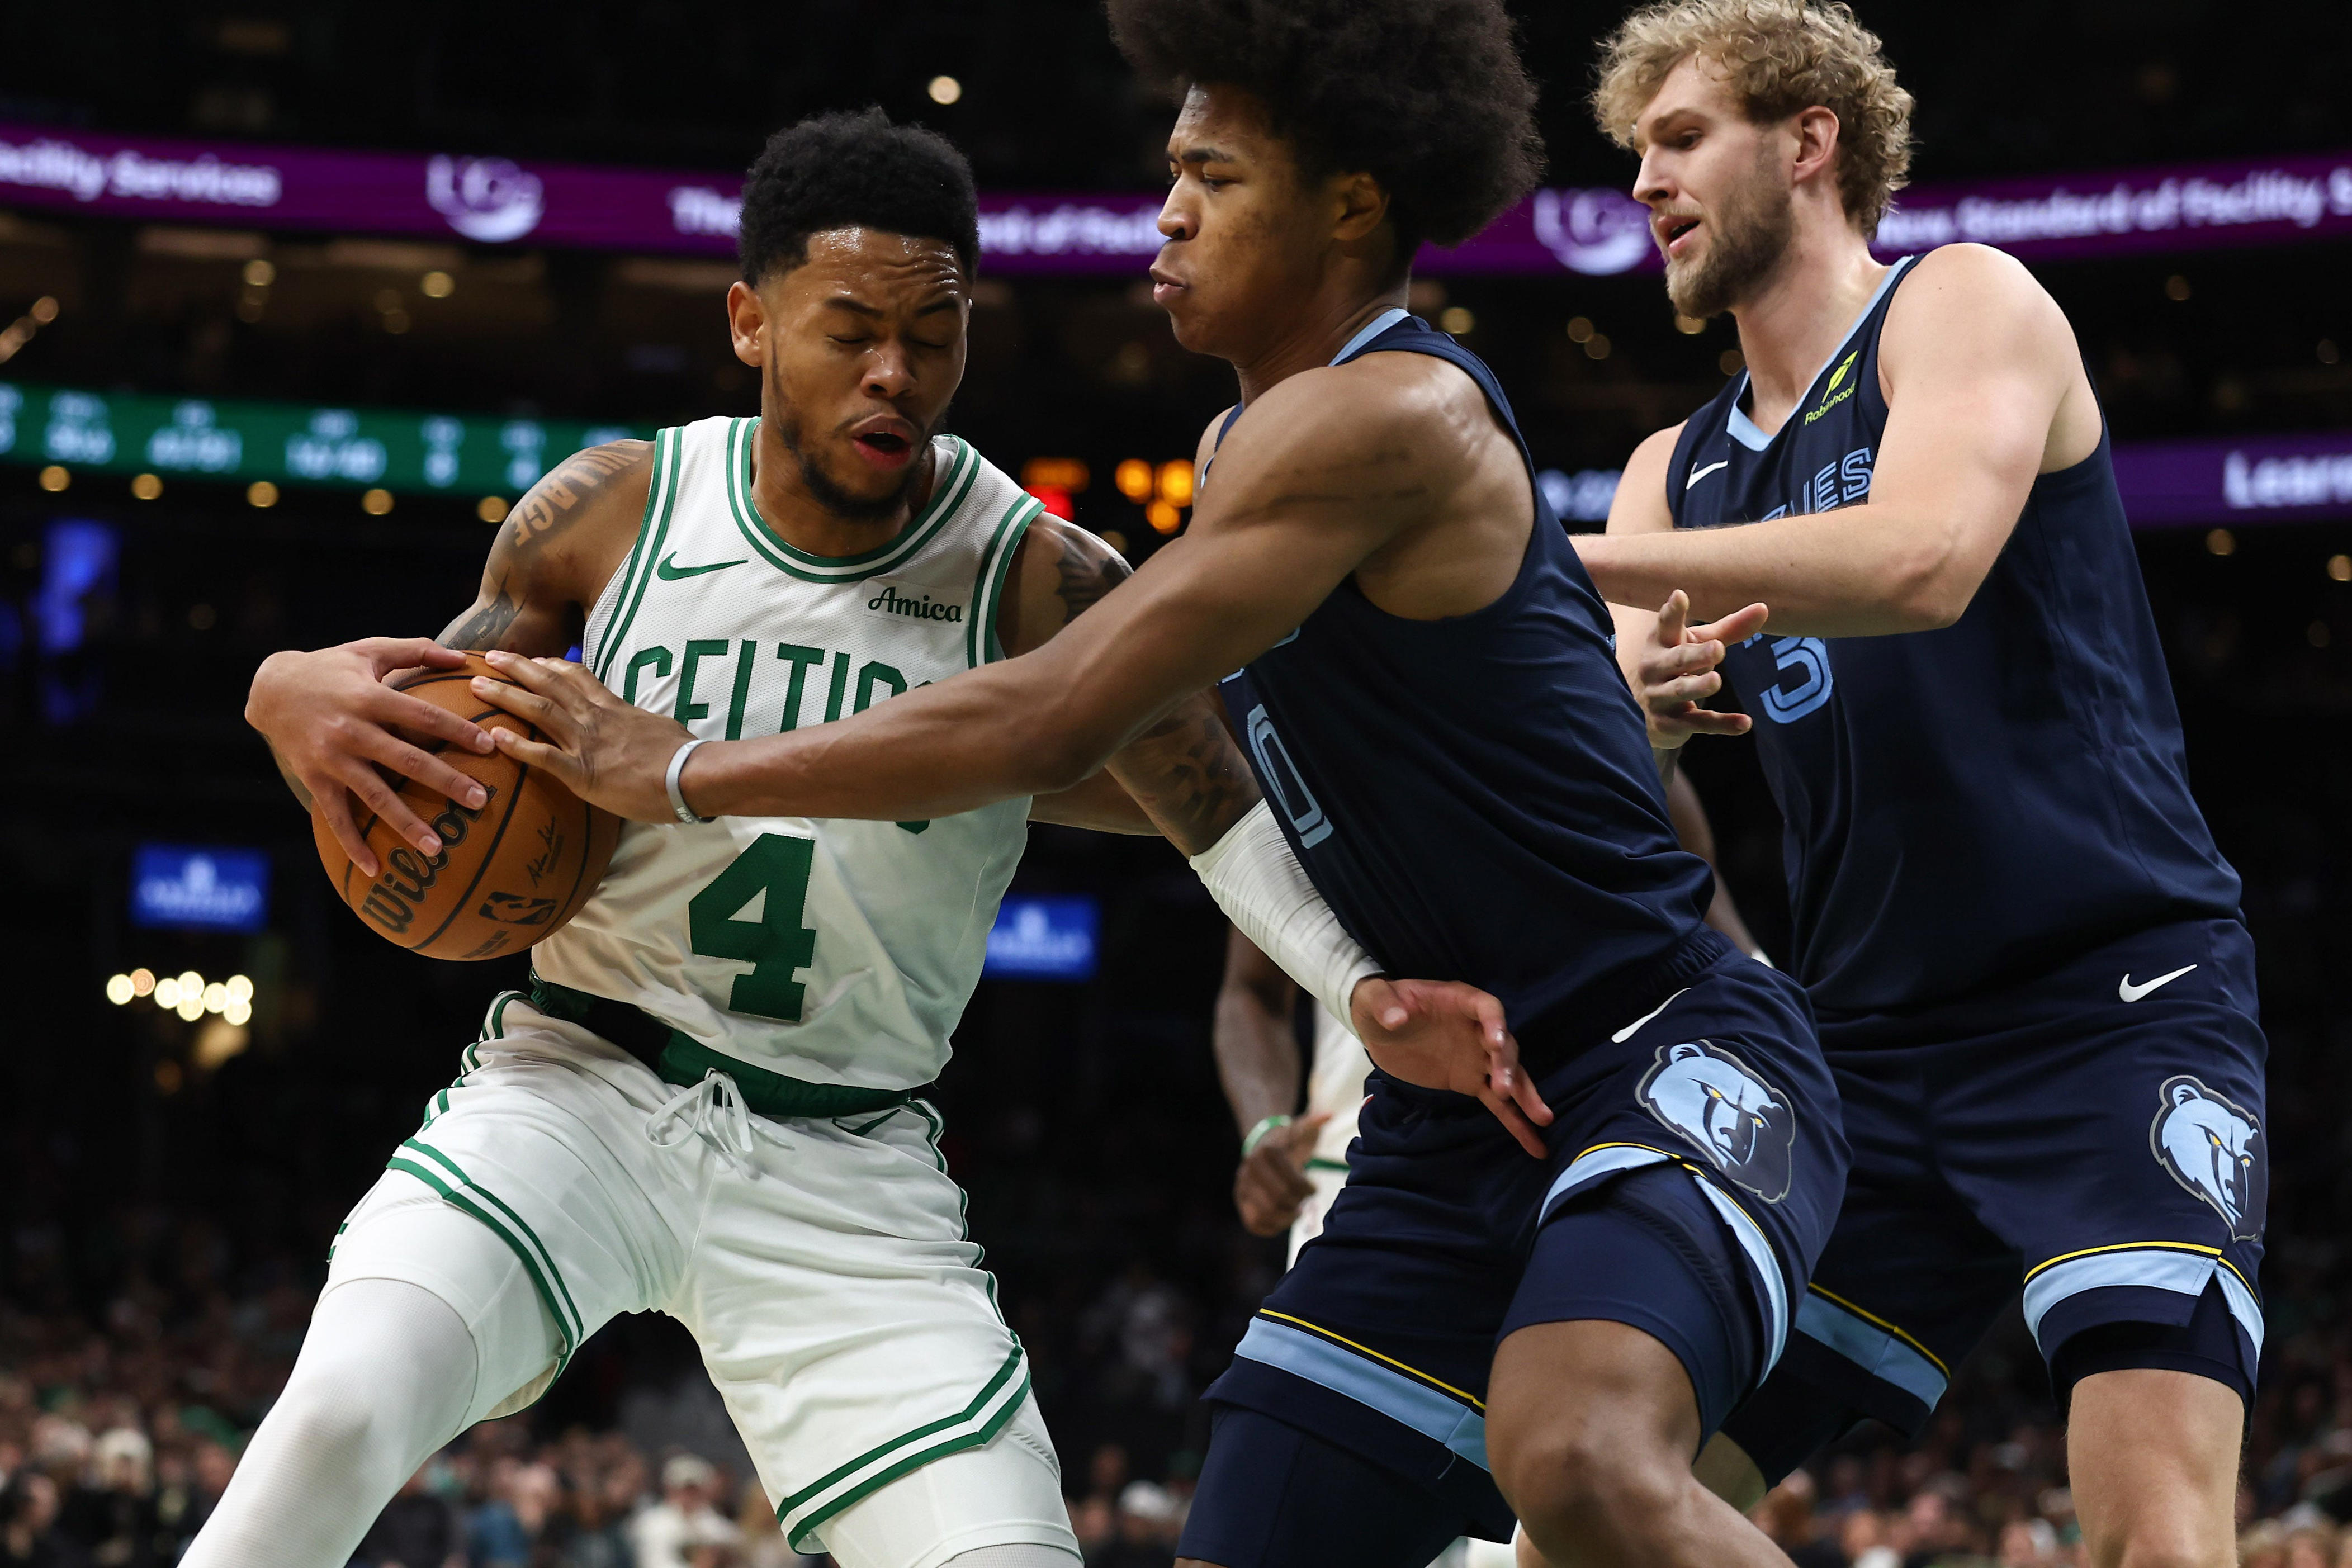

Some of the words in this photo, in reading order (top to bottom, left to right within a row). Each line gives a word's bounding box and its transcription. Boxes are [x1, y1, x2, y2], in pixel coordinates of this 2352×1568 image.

[2180, 169, 2323, 228] Facility
[1805, 378, 1856, 425] Robinhood
[868, 586, 963, 623] Amica
[689, 832, 816, 1022] 4
